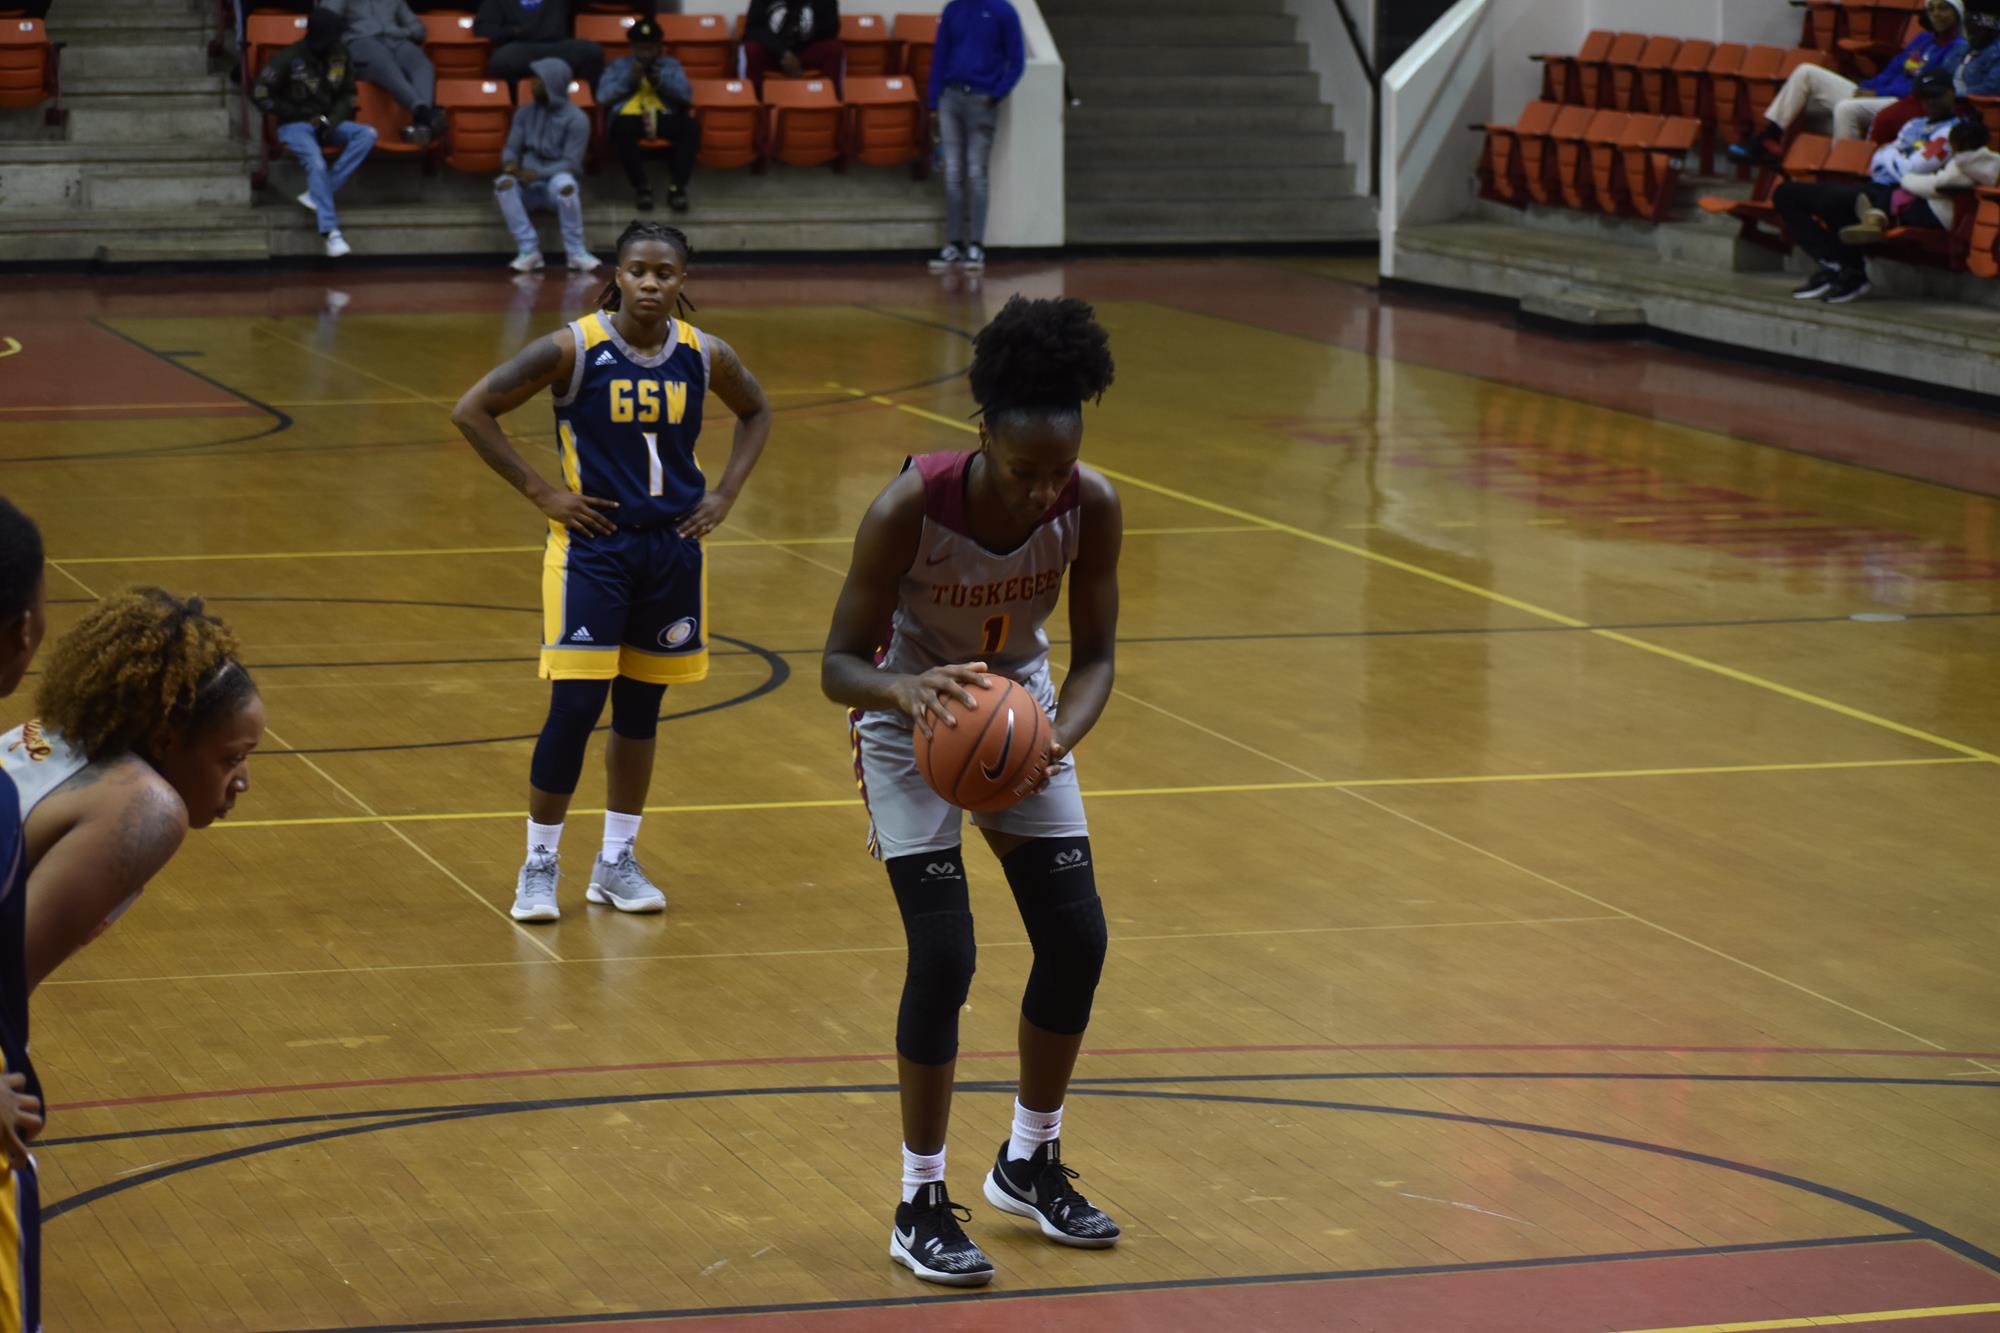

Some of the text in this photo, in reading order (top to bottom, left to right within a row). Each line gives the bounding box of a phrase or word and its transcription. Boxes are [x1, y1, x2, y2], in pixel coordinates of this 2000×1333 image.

[609, 378, 687, 424] GSW
[642, 432, 664, 496] 1
[981, 613, 1010, 654] 1
